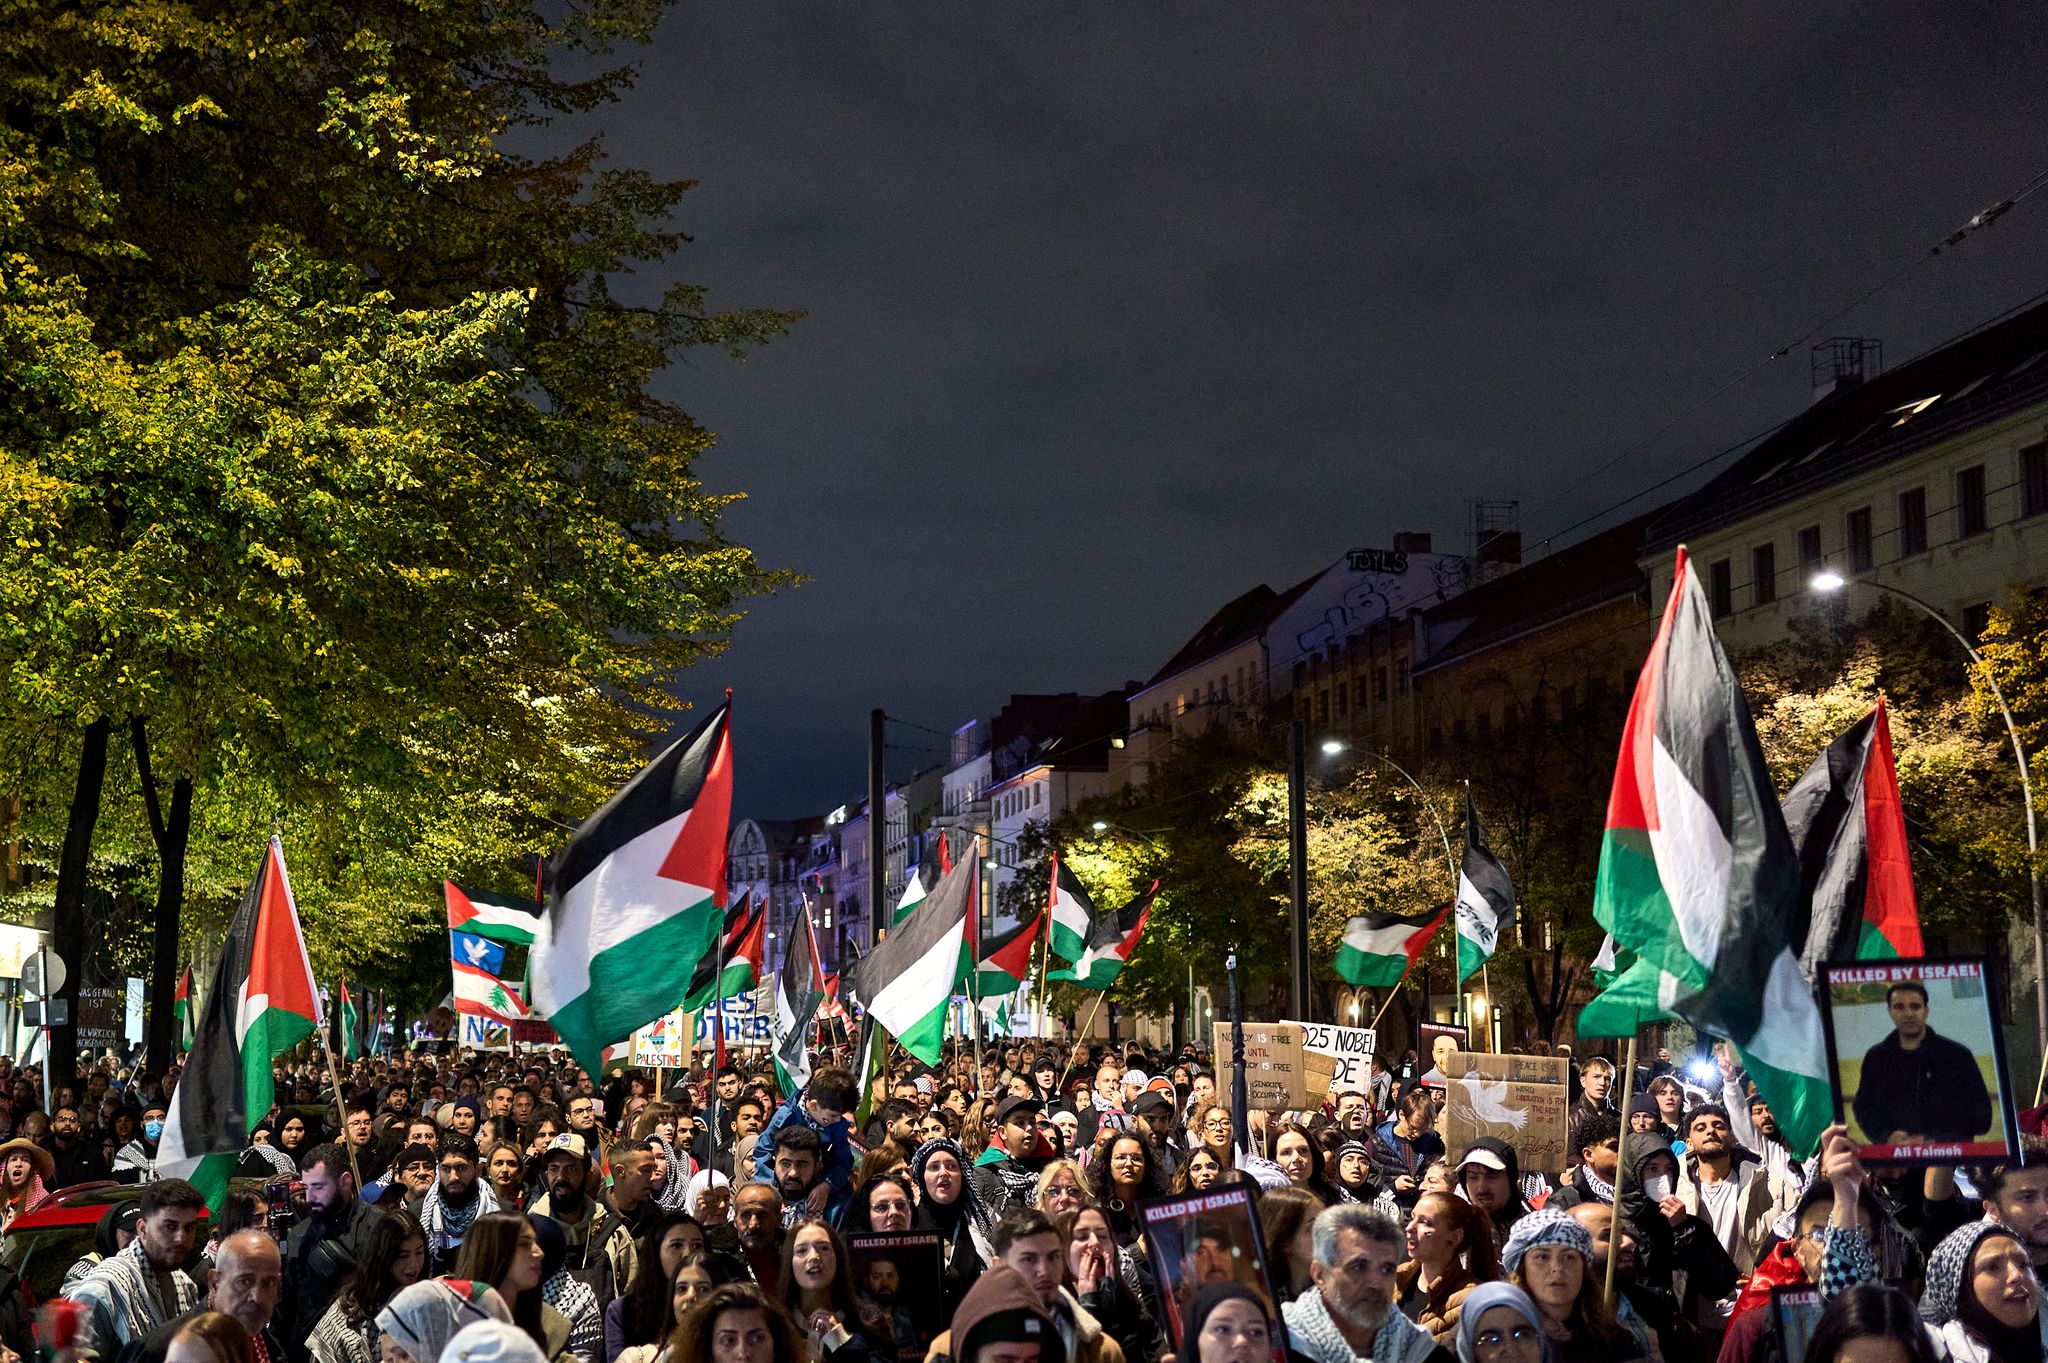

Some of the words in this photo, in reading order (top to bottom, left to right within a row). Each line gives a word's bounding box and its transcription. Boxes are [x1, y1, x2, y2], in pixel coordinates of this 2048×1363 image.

[1829, 968, 1887, 984] KILLED
[1891, 967, 1917, 981] BY
[1918, 964, 1978, 979] ISRAEL
[89, 999, 104, 1008] IST
[1447, 1026, 1466, 1034] ISRAEL
[1222, 1032, 1253, 1042] NODY
[1258, 1034, 1267, 1043] IS
[1272, 1035, 1292, 1045] FREE
[1335, 1030, 1375, 1056] NOBEL
[1247, 1048, 1270, 1058] UNTIL
[636, 1053, 681, 1067] PALESTINE
[1262, 1062, 1270, 1070] IS
[1273, 1063, 1292, 1073] FREE
[1514, 1062, 1537, 1071] PEACE
[1541, 1063, 1549, 1071] IS
[1252, 1080, 1284, 1090] GENOCIDE
[1515, 1094, 1545, 1104] LIBERATION
[1547, 1097, 1553, 1105] IS
[1531, 1105, 1543, 1113] THE
[1544, 1105, 1560, 1114] REST
[1893, 1145, 1911, 1158] Ali
[1145, 1203, 1186, 1221] KILLED
[1187, 1200, 1204, 1213] BY
[1205, 1191, 1247, 1208] ISRAEL
[853, 1239, 886, 1248] KILLED
[888, 1237, 902, 1246] BY
[903, 1235, 938, 1245] ISRAEL
